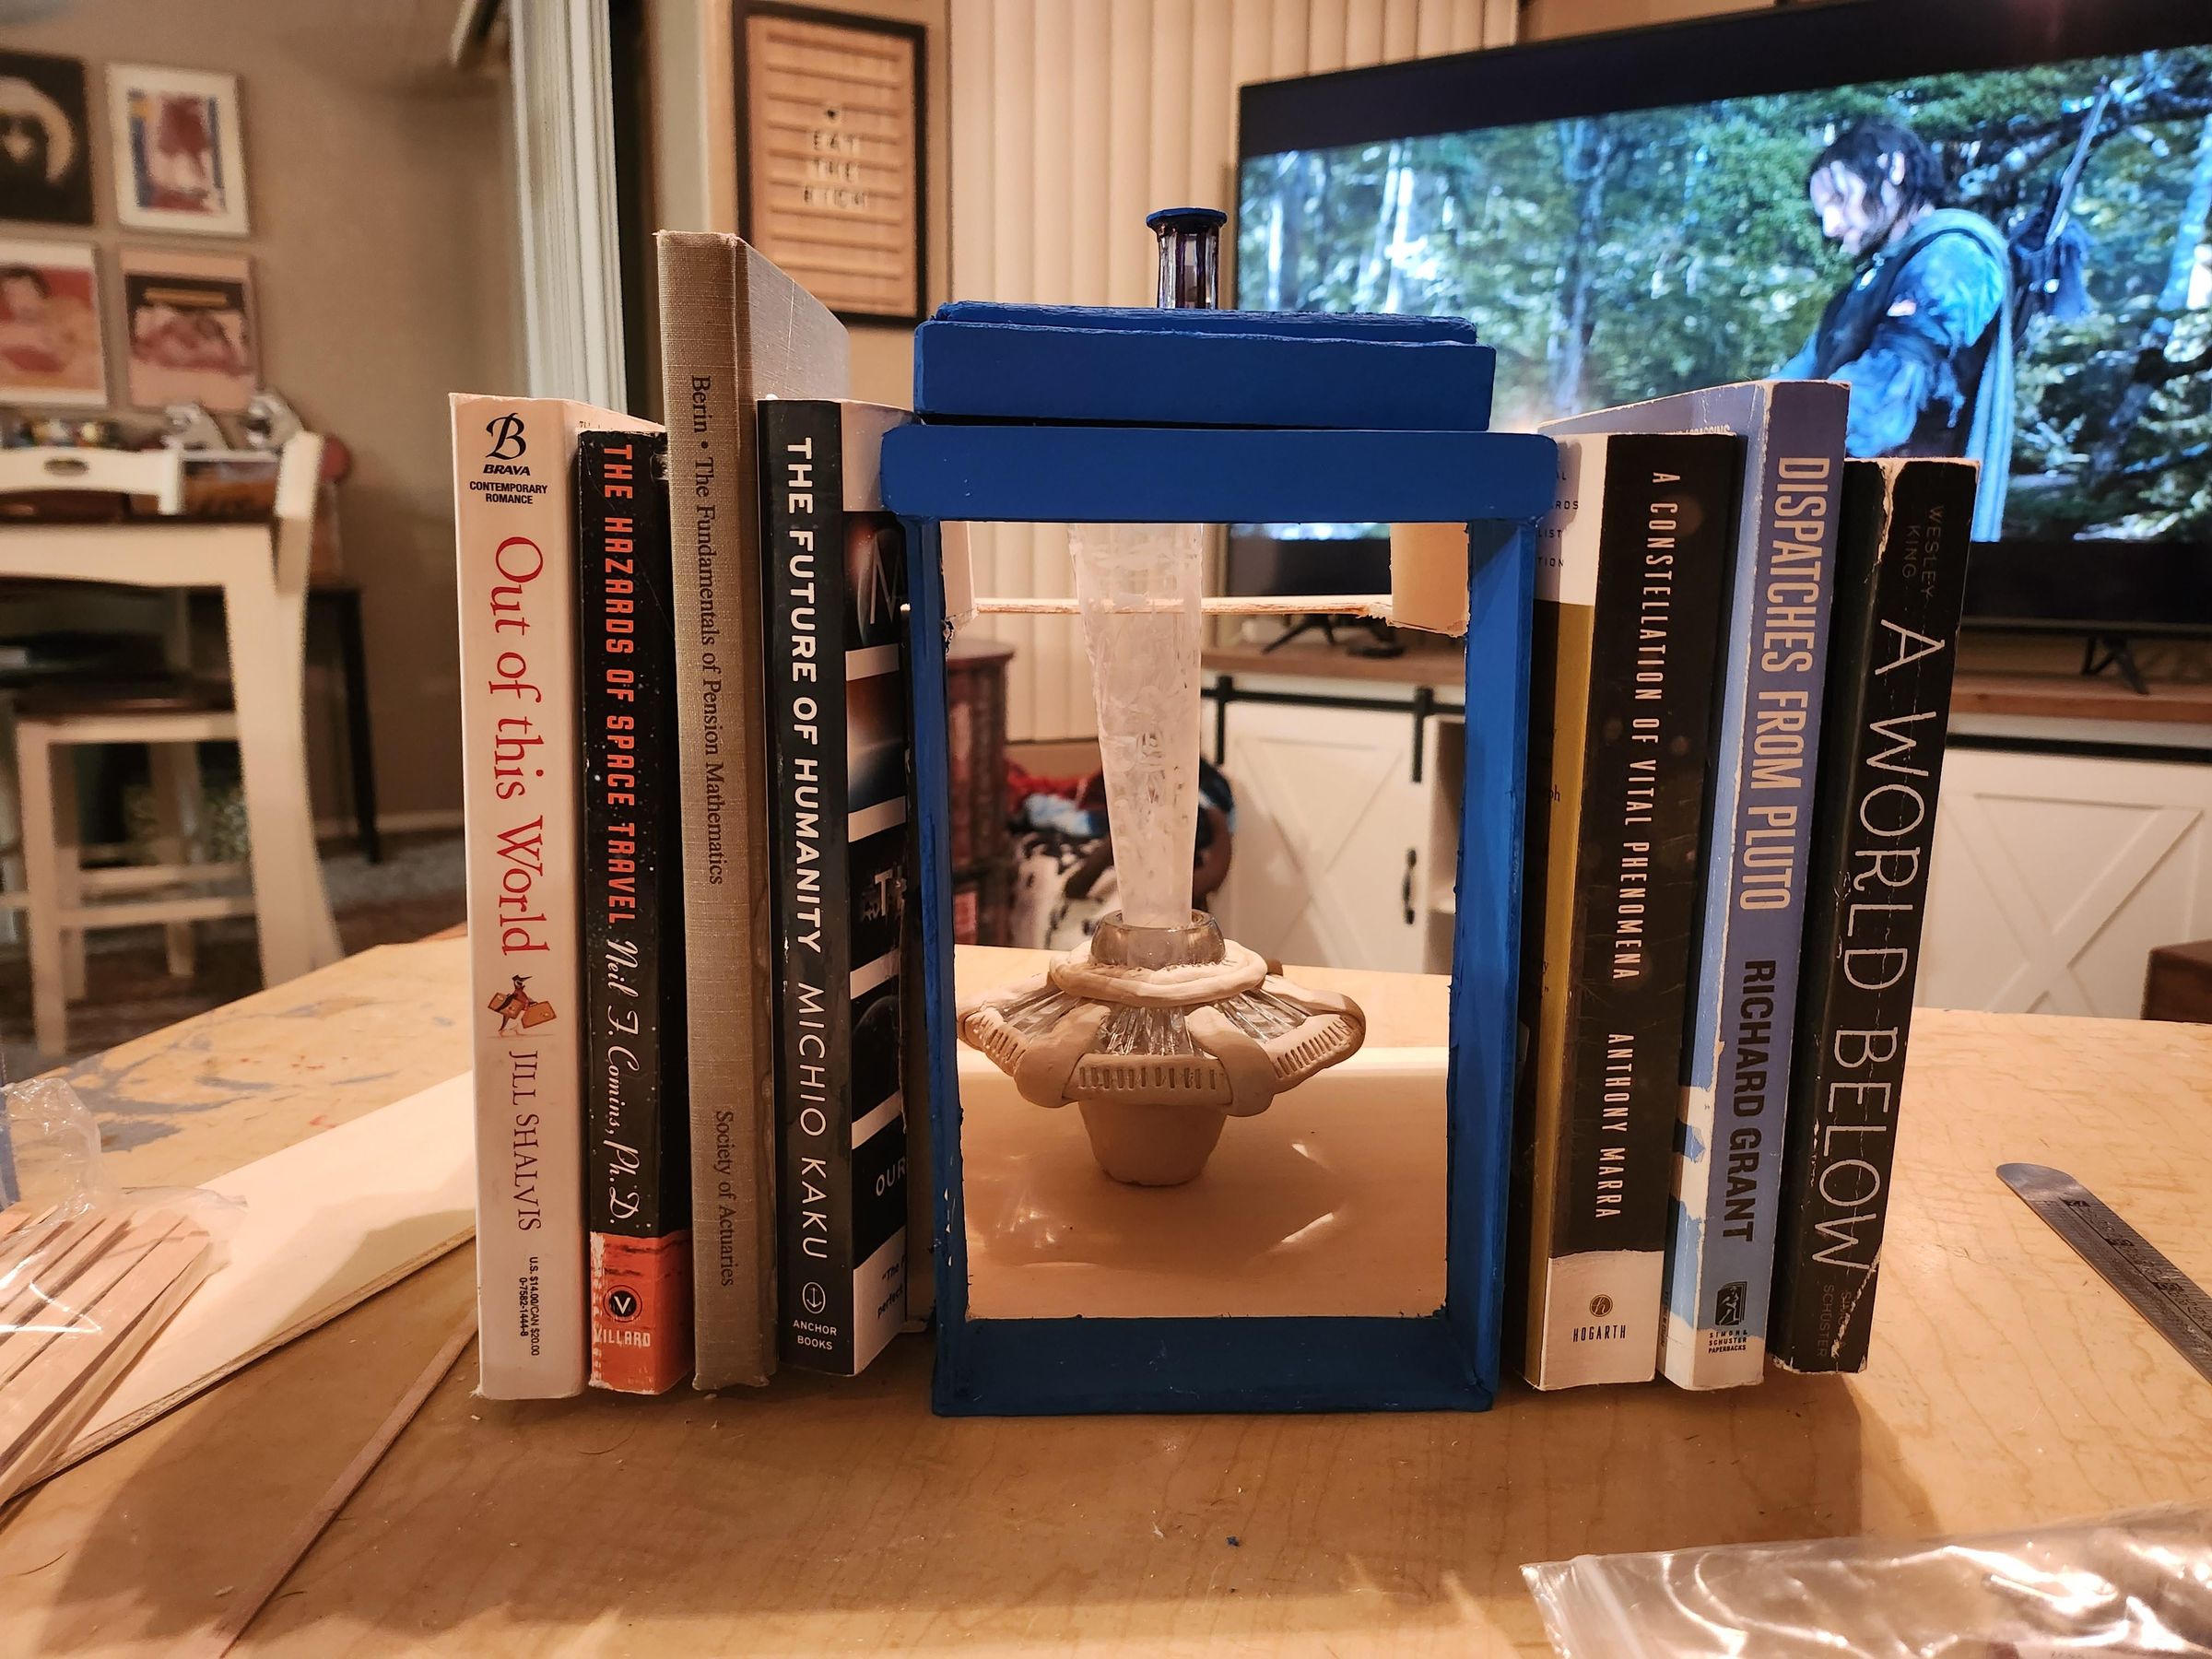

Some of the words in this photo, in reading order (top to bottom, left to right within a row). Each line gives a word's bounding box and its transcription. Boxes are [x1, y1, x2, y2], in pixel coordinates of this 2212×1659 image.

[692, 375, 712, 433] Berin
[470, 481, 547, 494] CONTEMPORARY
[483, 464, 531, 476] BRAVA
[486, 493, 533, 504] ROMANCE
[604, 444, 633, 499] THE
[695, 457, 714, 498] The
[785, 437, 813, 515] THE
[1652, 472, 1681, 483] A
[697, 504, 720, 644] Fundamentals
[1761, 456, 1830, 672] DISPATCHES
[1902, 525, 1921, 579] KING
[1921, 505, 1944, 597] WESLEY
[490, 536, 544, 636] Out
[604, 517, 636, 654] HAZARDS
[788, 530, 817, 683] FUTURE
[1635, 503, 1678, 700] CONSTELLATION
[488, 652, 542, 703] of
[701, 652, 722, 675] of
[1874, 618, 1945, 676] A
[606, 669, 635, 702] OF
[703, 678, 724, 756] Pension
[793, 696, 818, 746] OF
[1631, 717, 1659, 744] OF
[1750, 691, 1808, 789] FROM
[494, 716, 545, 800] this
[606, 715, 635, 806] SPACE
[705, 761, 728, 885] Mathematics
[1625, 759, 1656, 826] VITAL
[607, 824, 637, 924] TRAVEL
[794, 759, 823, 953] HUMANITY
[1738, 806, 1798, 912] PLUTO
[1843, 711, 1936, 991] WORLD
[497, 815, 550, 955] World
[1613, 842, 1650, 980] PHENOMENA
[605, 938, 639, 998] Neil
[797, 982, 828, 1137] MICHIO
[1735, 959, 1776, 1117] RICHARD
[508, 1051, 538, 1105] JILL
[605, 1045, 640, 1135] Comins,
[1599, 1033, 1634, 1133] ANTHONY
[512, 1113, 542, 1231] SHALVIS
[713, 1111, 735, 1175] Society
[1812, 1026, 1898, 1273] BELOW
[718, 1182, 736, 1200] of
[800, 1156, 828, 1261] KAKU
[876, 1157, 906, 1196] OUR
[1595, 1147, 1630, 1219] MARRA
[1722, 1126, 1762, 1241] GRANT
[529, 1256, 538, 1275] U.S.
[719, 1205, 738, 1287] Actuaries
[519, 1277, 529, 1336] 0-7582-1444-8
[529, 1276, 539, 1326] $14.00/CAN
[614, 1296, 631, 1314] V
[793, 1319, 837, 1336] ANCHOR
[1573, 1325, 1626, 1342] HOGARTH
[1817, 1284, 1835, 1357] SCHUSTER
[530, 1328, 540, 1356] $20.00
[594, 1329, 651, 1347] VILLARD
[797, 1335, 833, 1350] BOOKS
[1708, 1345, 1746, 1354] PAPERBACKS
[1709, 1336, 1747, 1347] SCHUSTER
[1710, 1330, 1740, 1338] SIMON
